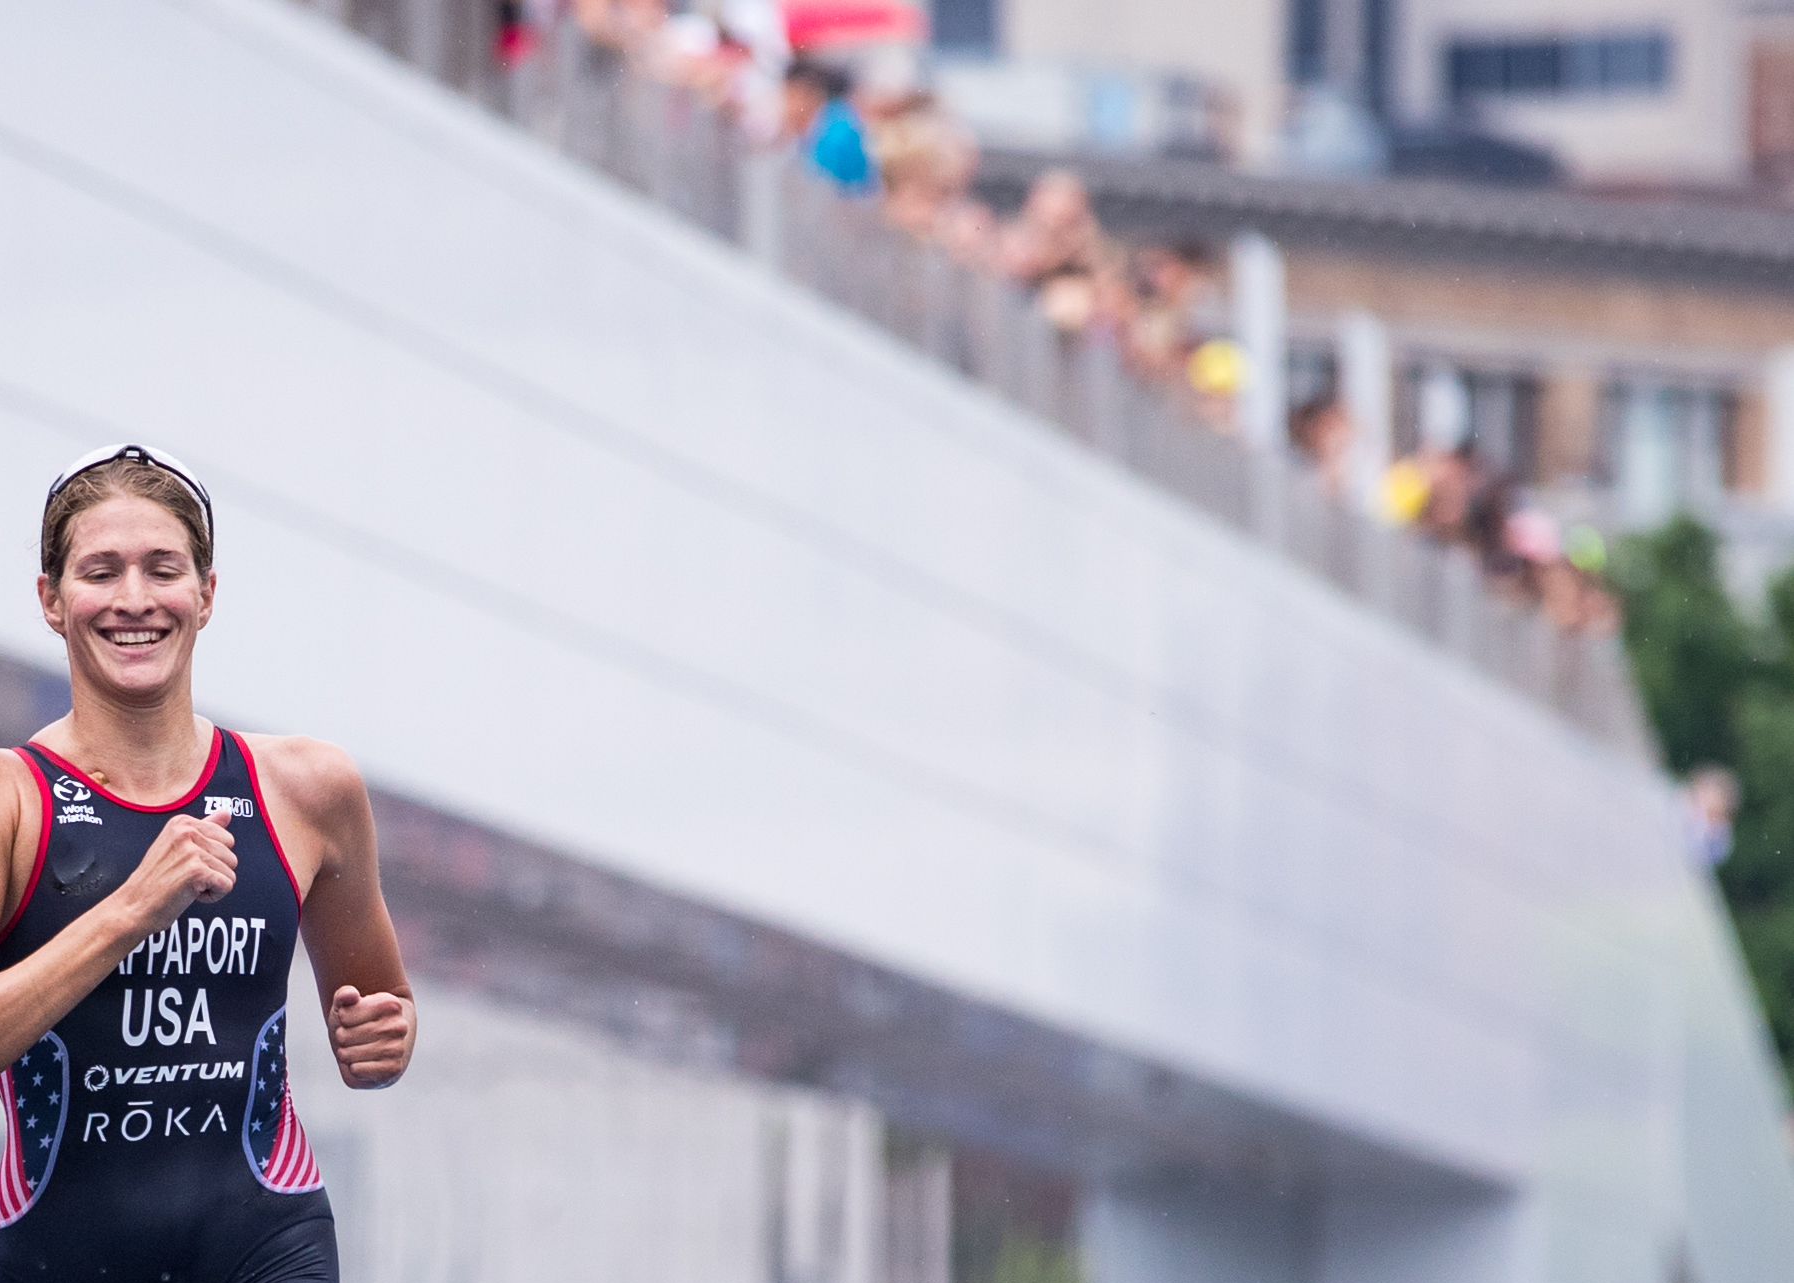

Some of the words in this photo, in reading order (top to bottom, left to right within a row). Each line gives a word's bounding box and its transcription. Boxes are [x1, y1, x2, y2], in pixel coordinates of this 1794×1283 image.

[56, 813, 103, 826] Triathlon
[62, 804, 95, 815] World
[118, 916, 266, 976] PPAPORT
[121, 986, 218, 1048] USA
[113, 1060, 245, 1085] VENTUM
